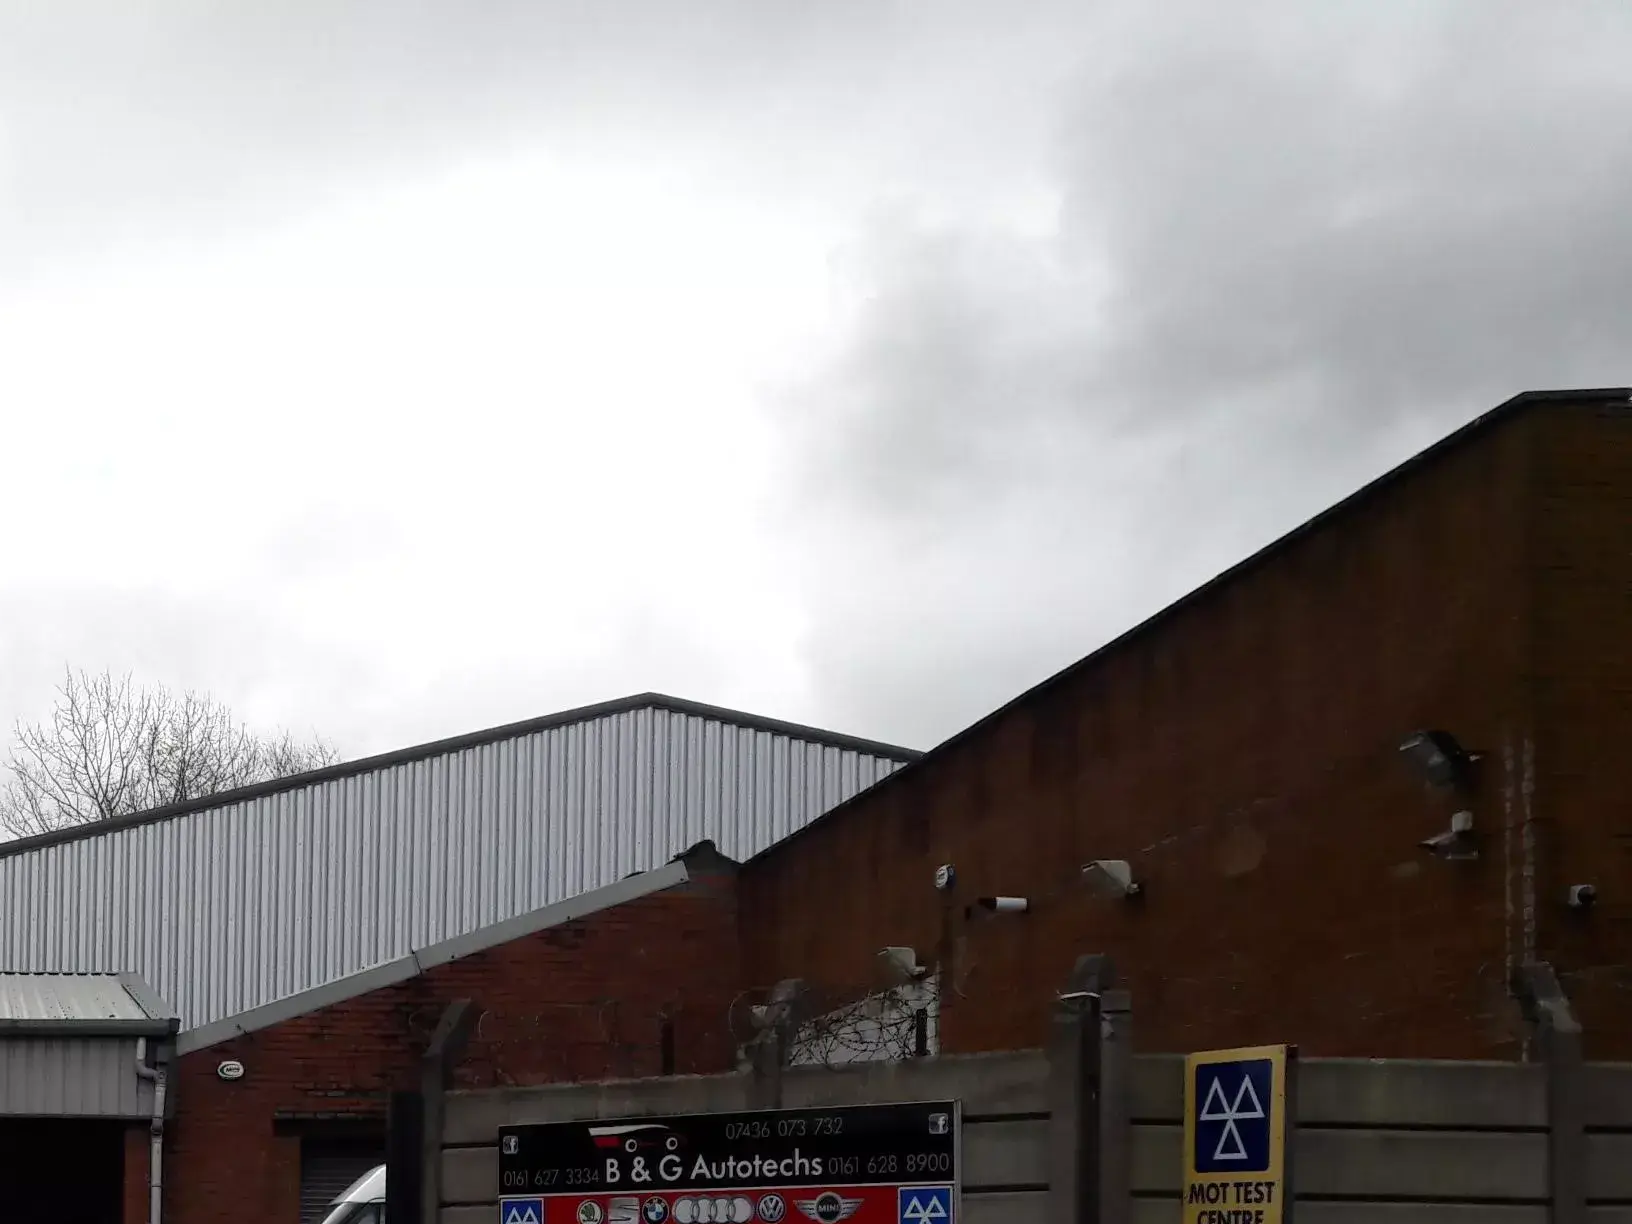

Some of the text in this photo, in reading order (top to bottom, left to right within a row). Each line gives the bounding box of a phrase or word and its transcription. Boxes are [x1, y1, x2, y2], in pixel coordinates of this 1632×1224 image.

[725, 1116, 844, 1140] 07436 073 732
[606, 1147, 824, 1184] B & G Autotechs
[828, 1152, 951, 1175] 0161 628 8900
[503, 1167, 601, 1187] 0161 627 3334
[1189, 1181, 1276, 1204] MOT TEST
